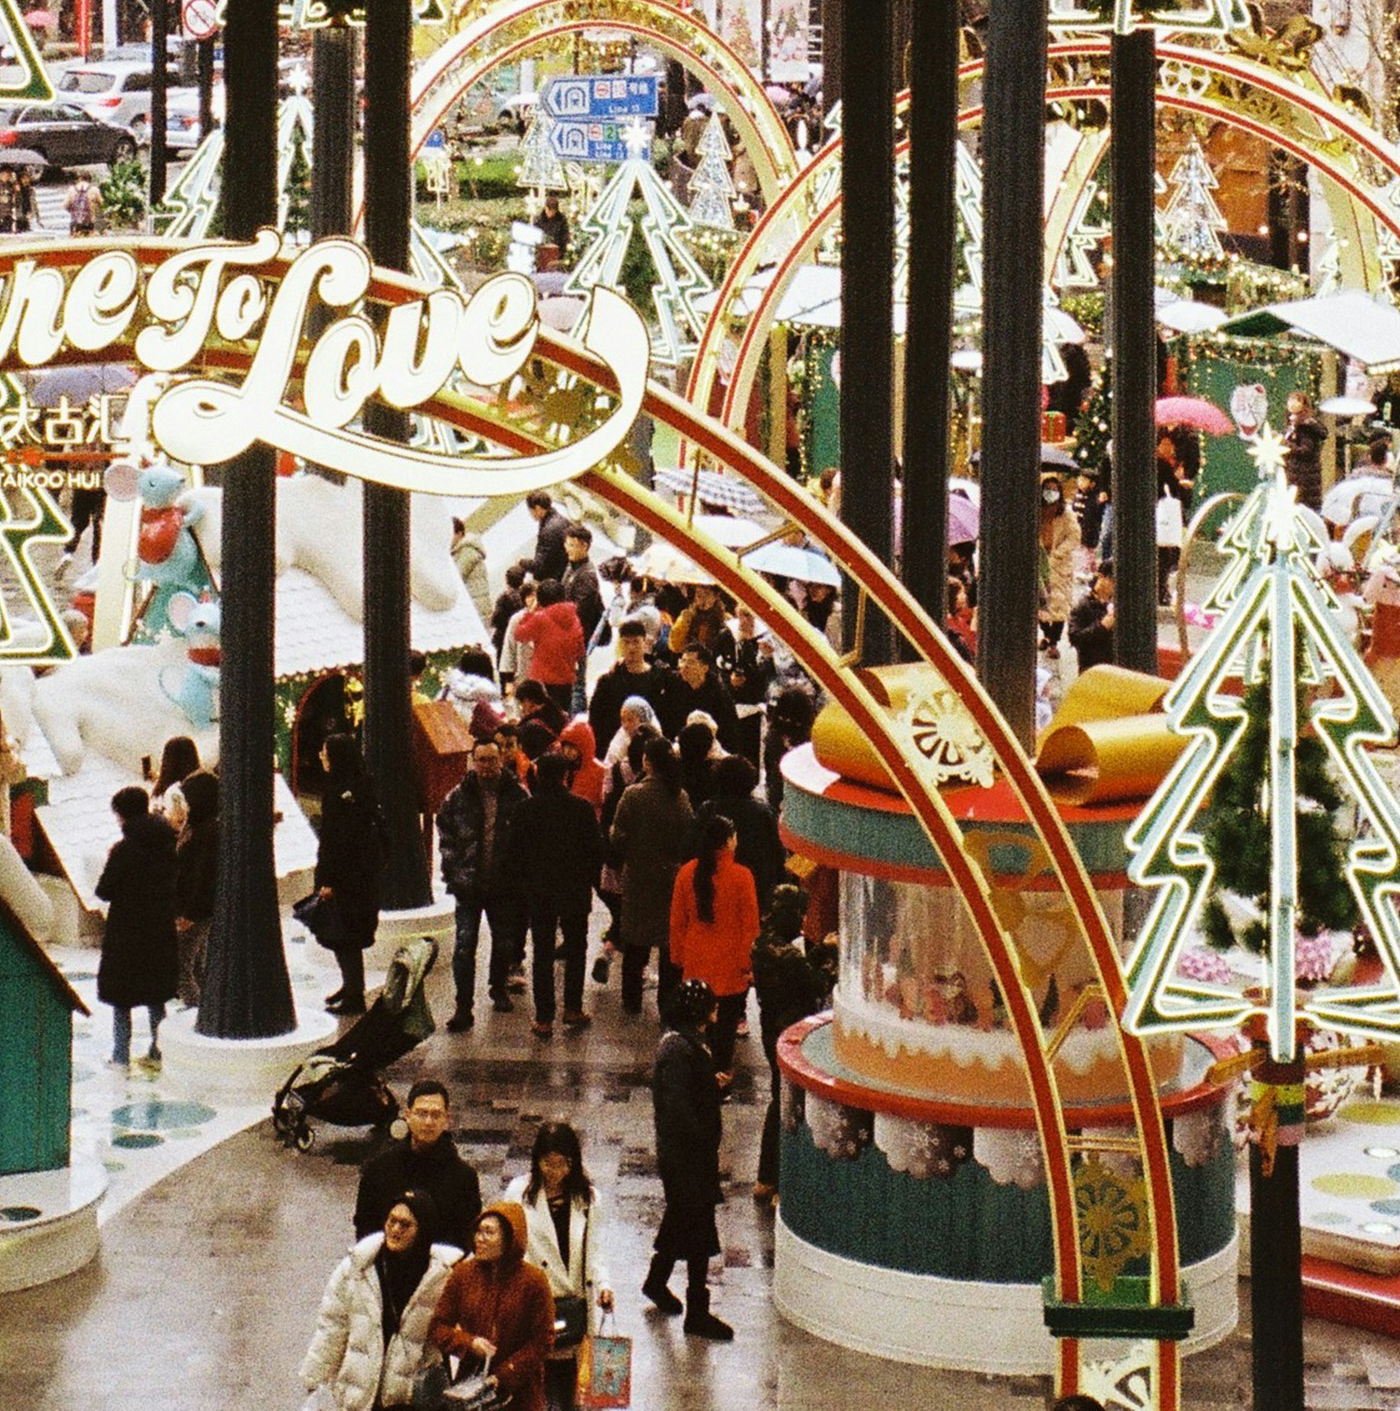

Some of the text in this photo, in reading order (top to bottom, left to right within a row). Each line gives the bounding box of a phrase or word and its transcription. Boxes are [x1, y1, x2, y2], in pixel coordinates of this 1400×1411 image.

[134, 227, 282, 371] To
[151, 236, 539, 466] Love
[68, 473, 100, 489] HUI
